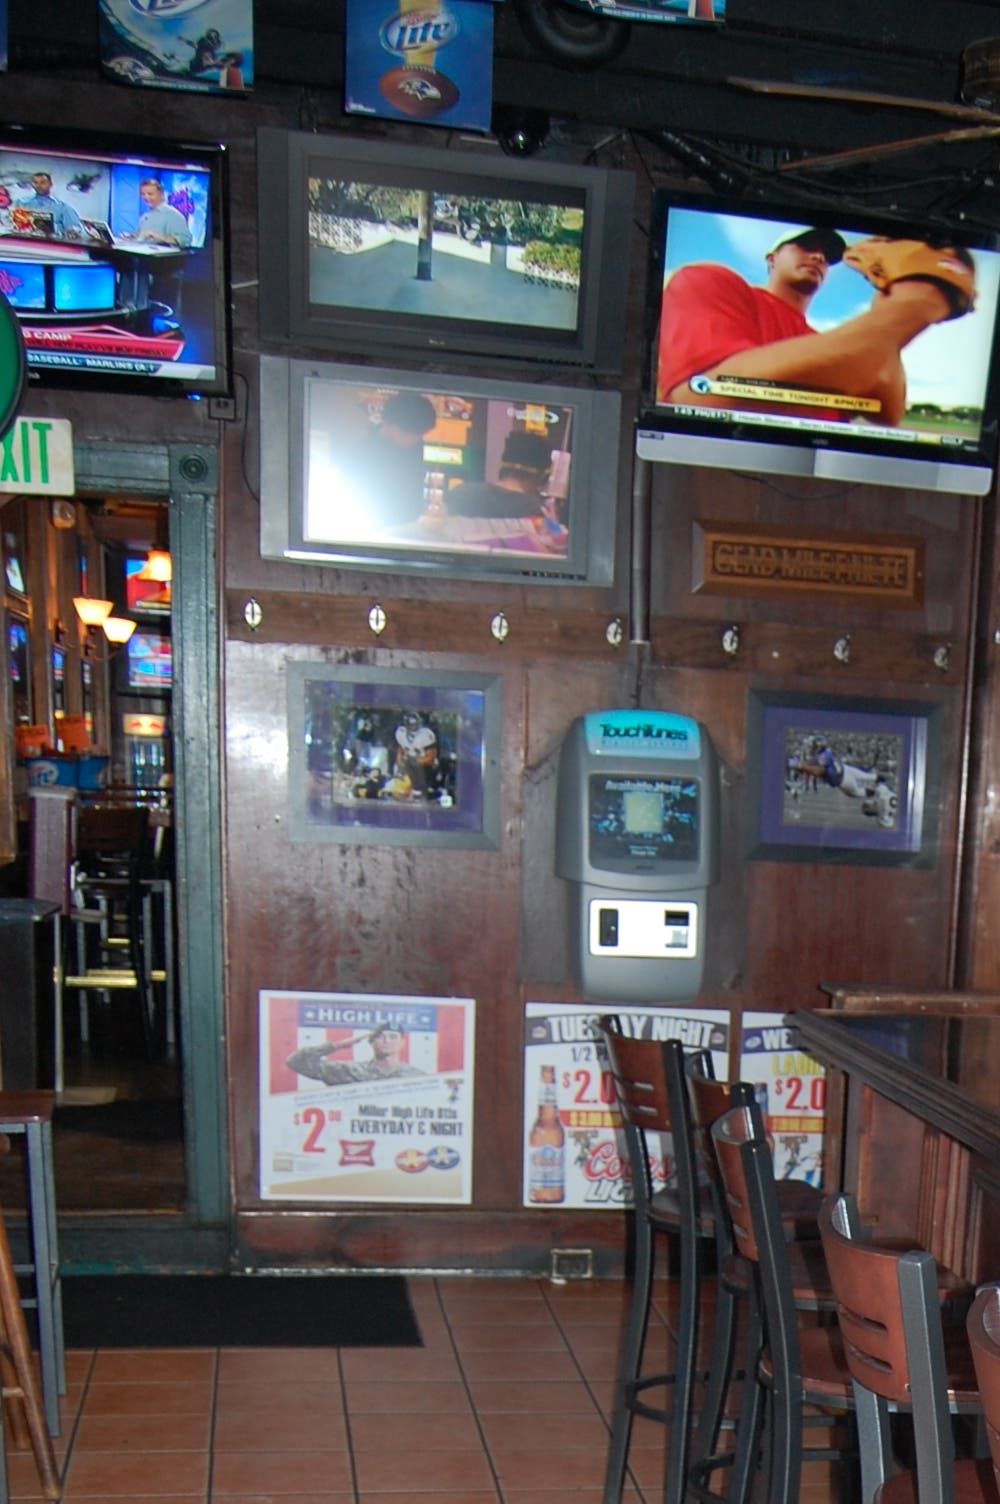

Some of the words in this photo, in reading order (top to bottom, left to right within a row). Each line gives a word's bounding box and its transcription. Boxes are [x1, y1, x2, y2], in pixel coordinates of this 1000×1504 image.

[394, 22, 451, 50] Lite
[86, 358, 134, 371] MARLINS
[719, 384, 758, 396] SPECIAL
[763, 389, 785, 399] TIME
[789, 391, 829, 405] TONIGHT
[0, 421, 52, 484] XIT
[600, 724, 689, 741] TouchTunes
[319, 1007, 371, 1023] HIGH
[375, 1010, 418, 1026] LIFE
[548, 1013, 649, 1043] TUESY
[651, 1015, 716, 1049] NIGHT
[571, 1046, 591, 1062] 1/2
[562, 1069, 618, 1106] $2.0
[775, 1076, 827, 1111] $2.0
[358, 1104, 388, 1117] Miller
[391, 1105, 413, 1119] High
[416, 1106, 434, 1118] Life
[350, 1119, 412, 1136] EVERYDAY
[417, 1121, 426, 1135] &
[429, 1121, 463, 1137] NIGHT
[584, 1141, 673, 1181] Coos
